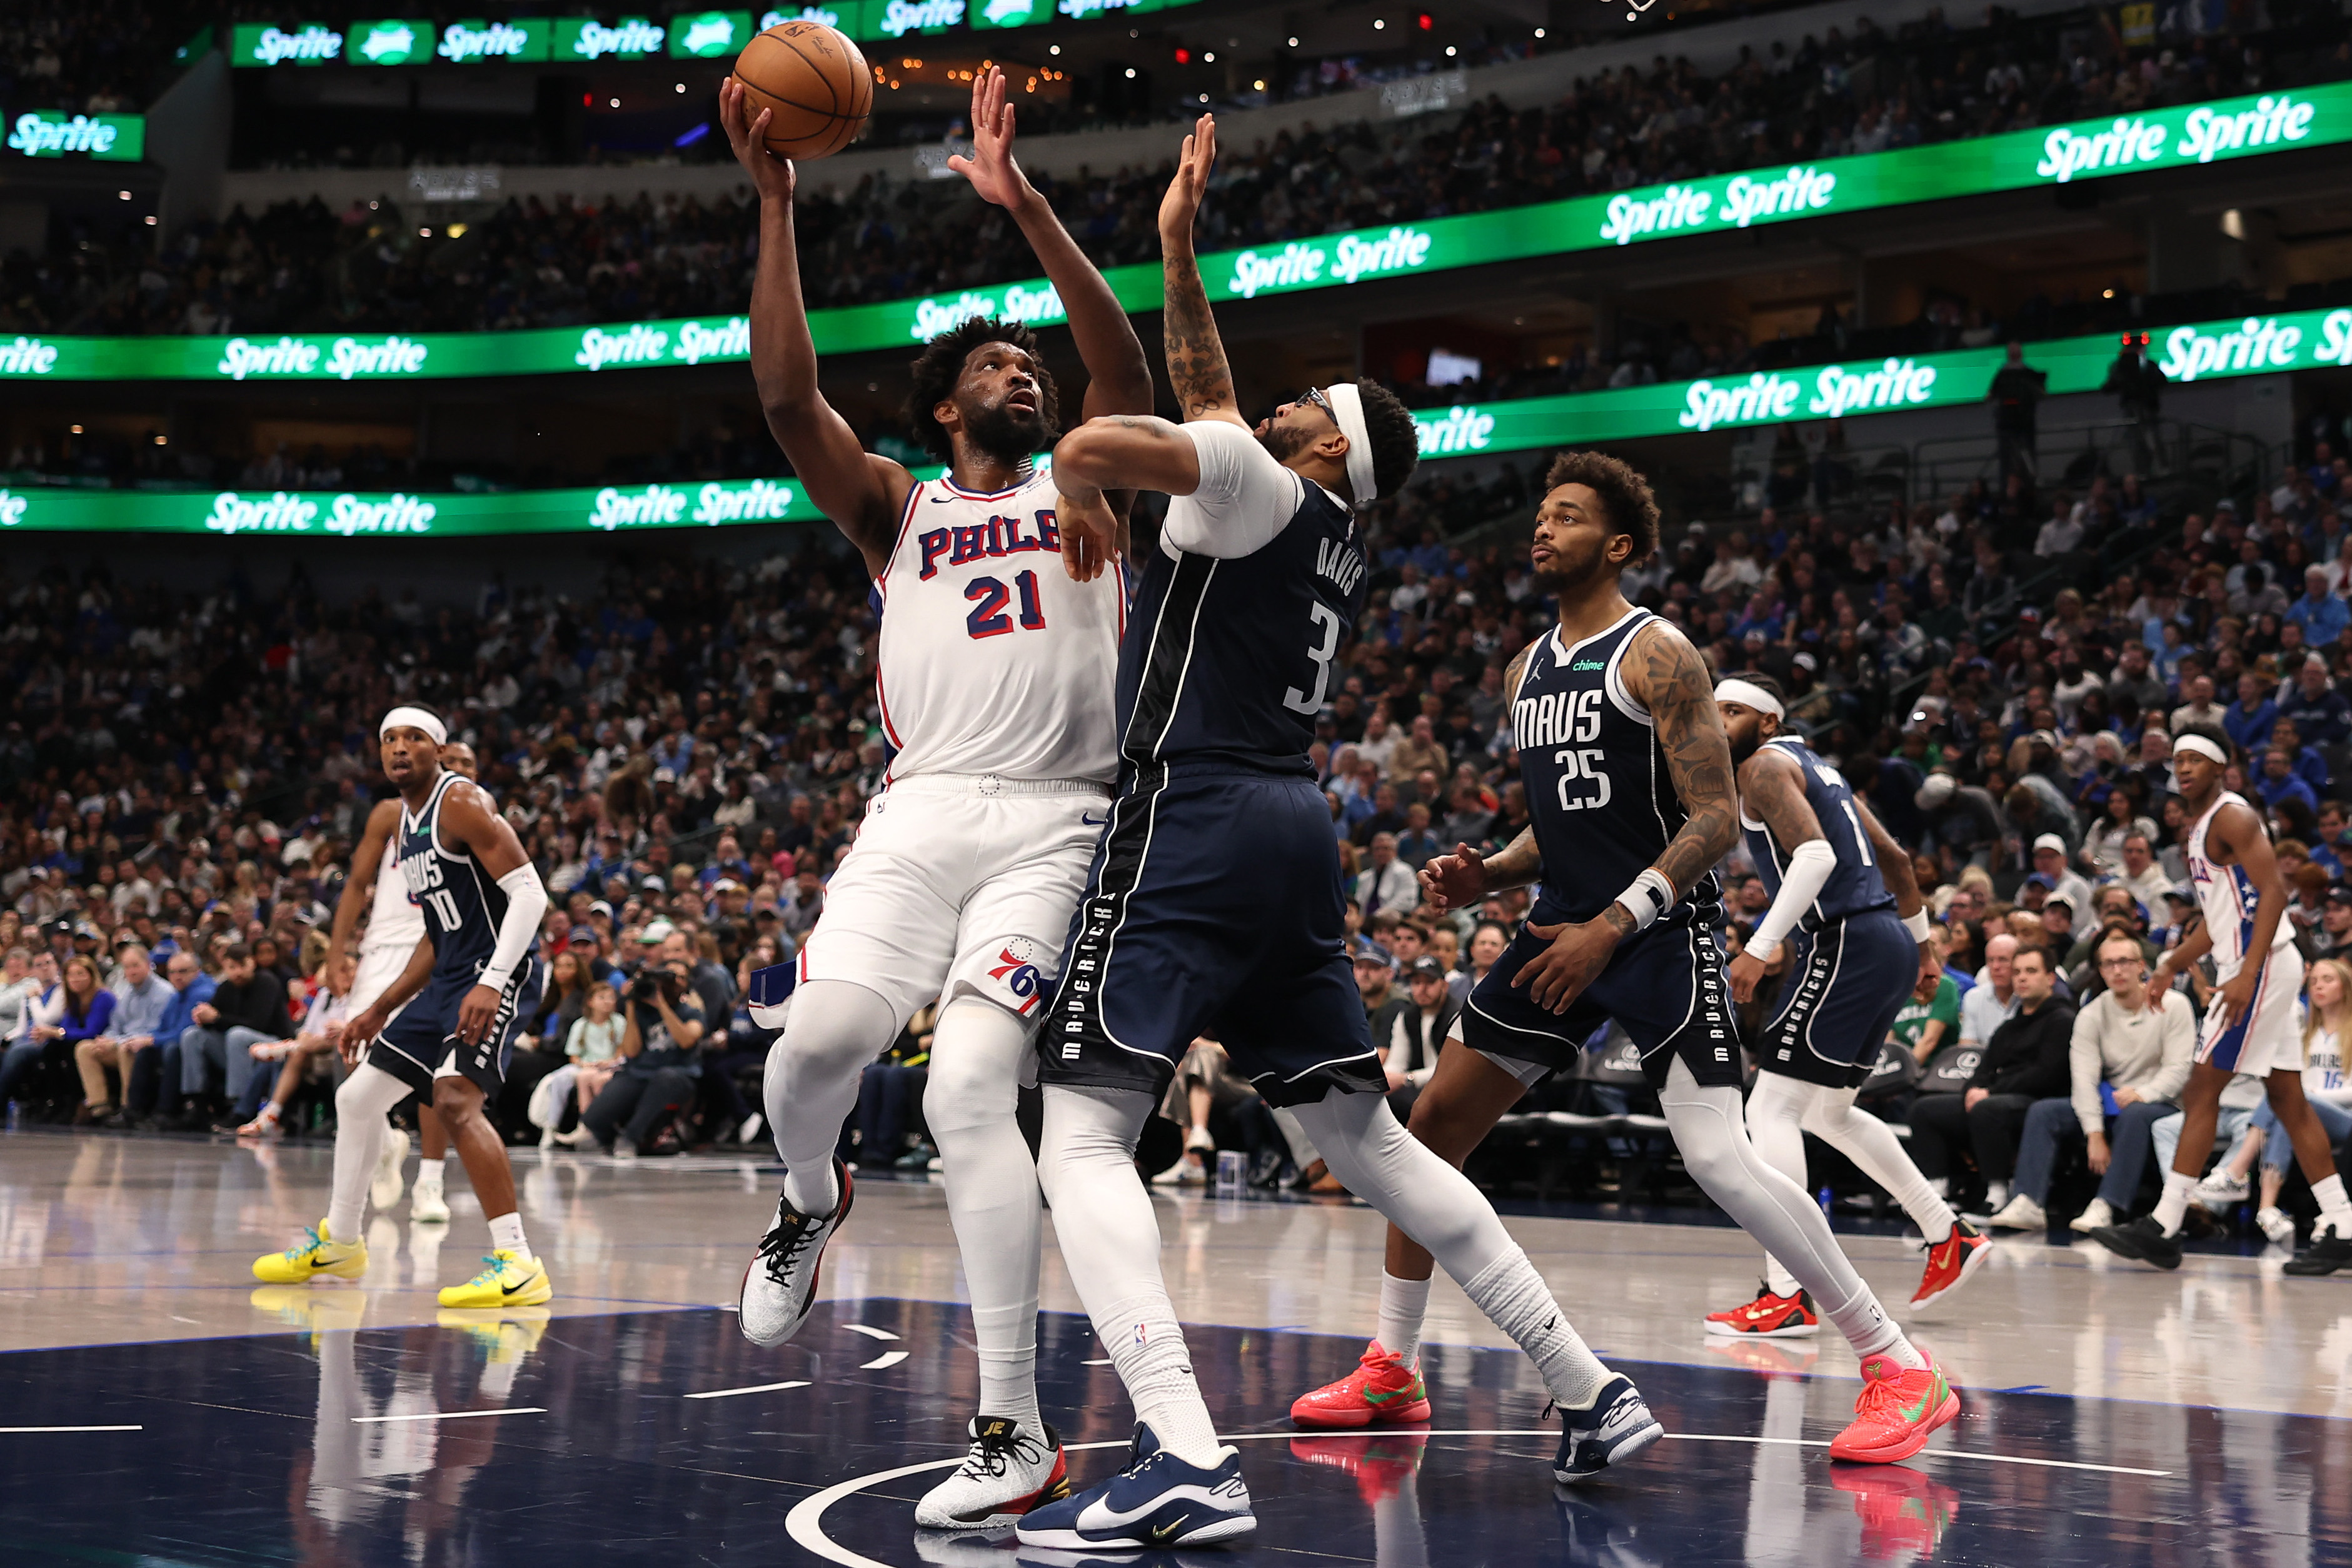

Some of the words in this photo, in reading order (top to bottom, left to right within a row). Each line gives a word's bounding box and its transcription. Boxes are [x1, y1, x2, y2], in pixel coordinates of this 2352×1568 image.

[254, 27, 343, 66] Sprite
[438, 23, 528, 63] Sprite
[574, 20, 665, 59] Sprite
[9, 113, 116, 156] Sprite
[2036, 116, 2168, 183] Sprite
[2176, 94, 2316, 163] Sprite
[1599, 184, 1714, 245] Sprite
[1718, 165, 1837, 228] Sprite
[1228, 242, 1327, 299] Sprite
[1329, 226, 1432, 284] Sprite
[217, 335, 321, 381] Sprite
[324, 335, 429, 381] Sprite
[575, 323, 670, 372] Sprite
[2158, 316, 2303, 383] Sprite
[1678, 371, 1801, 432] Sprite
[1808, 356, 1937, 418] Sprite
[204, 490, 319, 535] Sprite
[323, 492, 437, 536] Sprite
[588, 483, 688, 531] Sprite
[691, 478, 794, 526] Sprite
[1317, 536, 1363, 596] DAVIS
[963, 570, 1046, 640] 21
[1282, 600, 1340, 716] 3
[1572, 658, 1605, 671] chime
[1555, 749, 1611, 811] 25
[423, 888, 463, 933] 10
[983, 1421, 1005, 1436] JE
